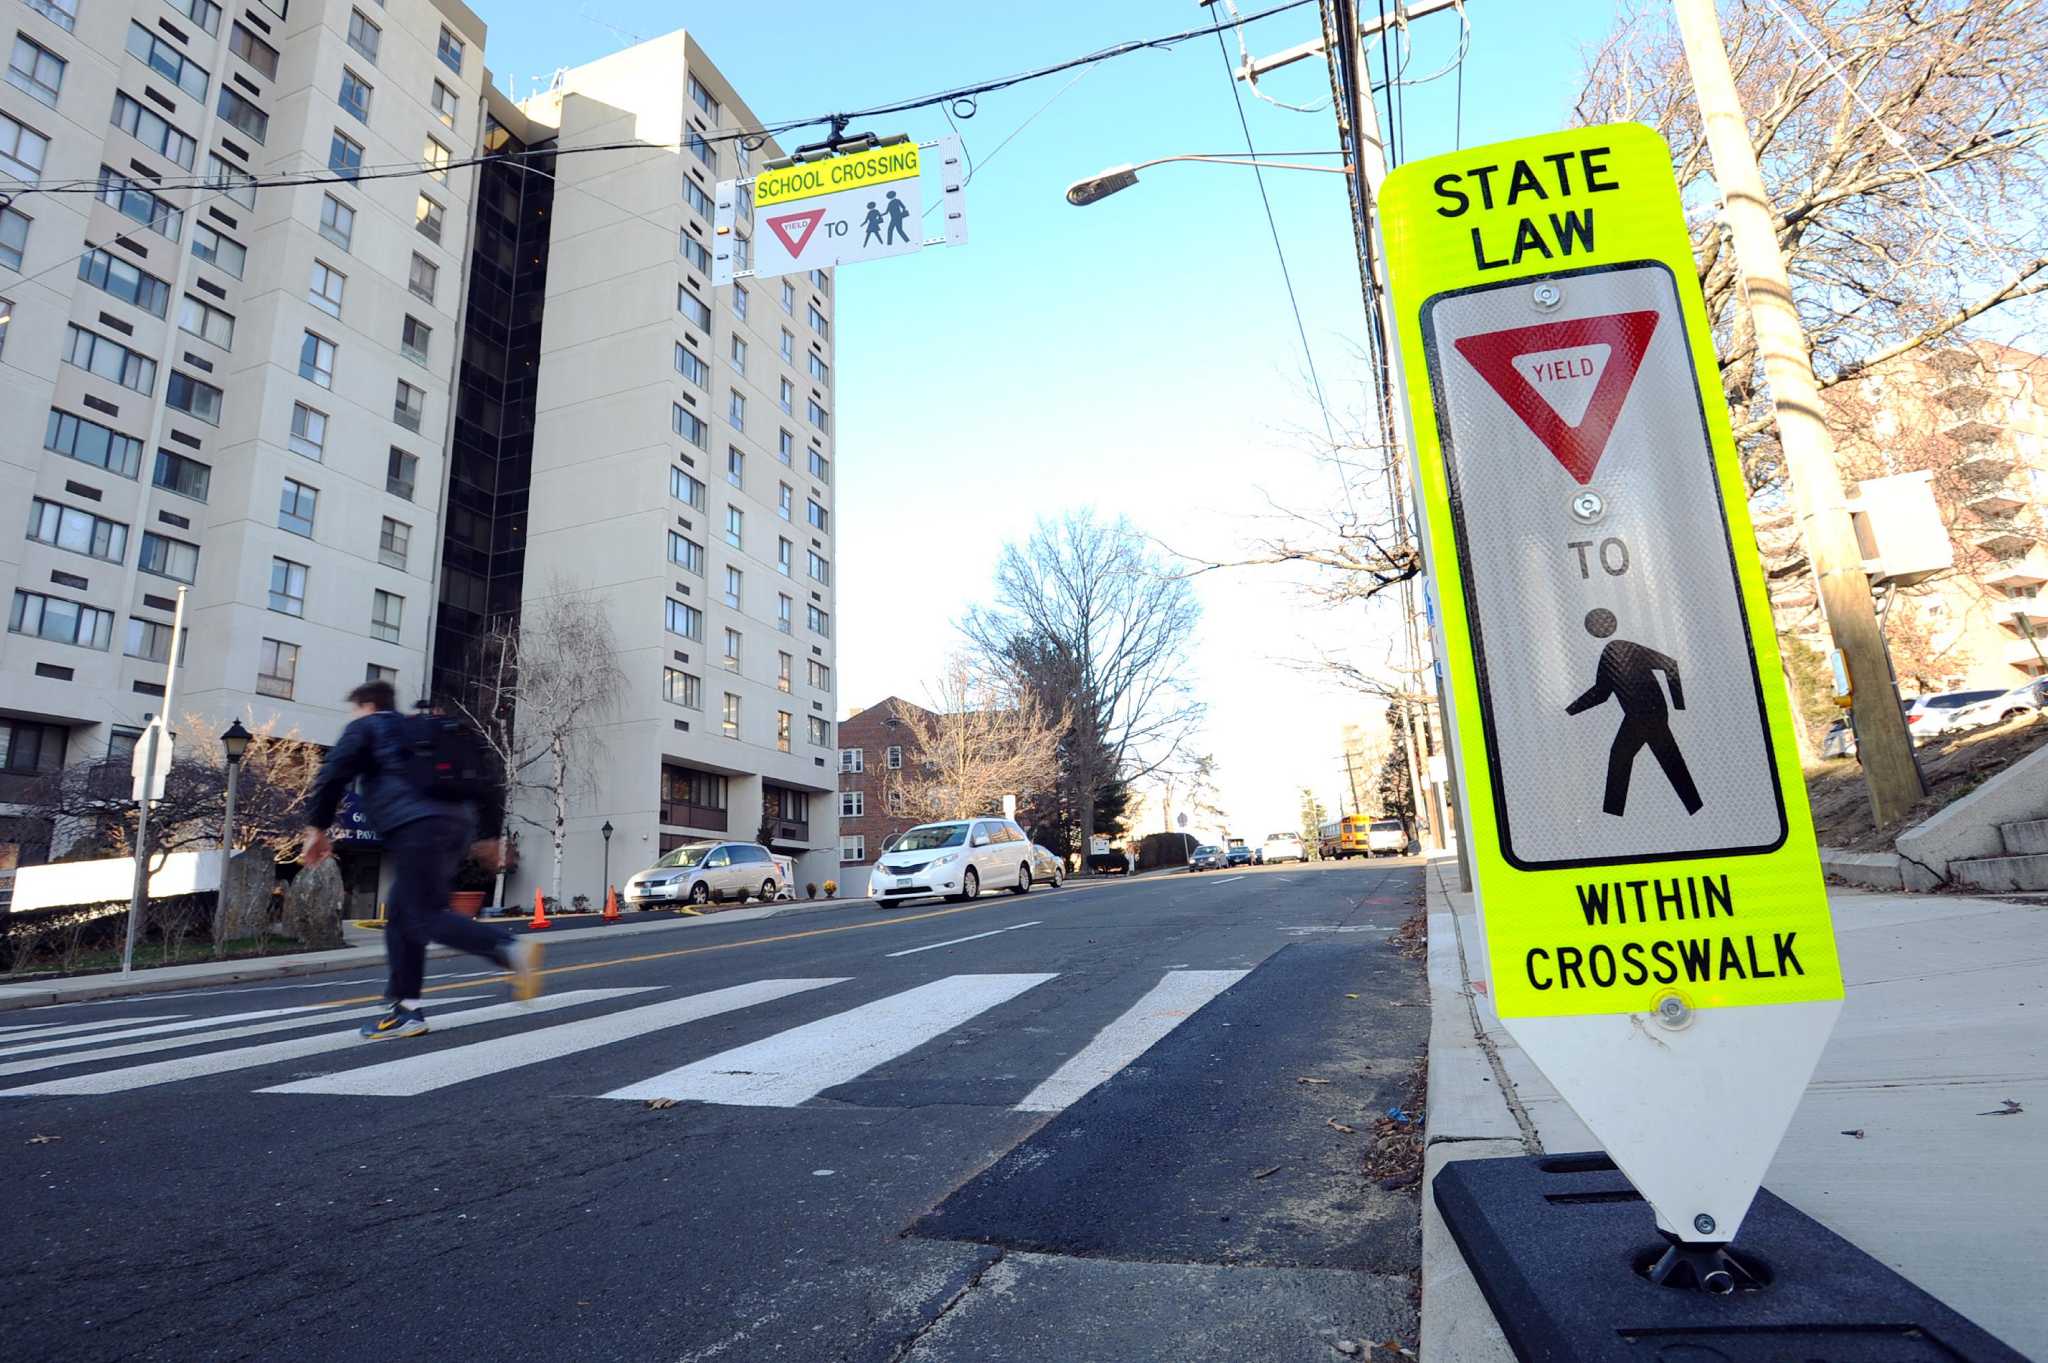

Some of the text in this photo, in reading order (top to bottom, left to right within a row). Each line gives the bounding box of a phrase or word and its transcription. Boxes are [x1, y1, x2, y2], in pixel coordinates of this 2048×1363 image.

[757, 151, 917, 199] SCHOOL CROSSING
[1434, 147, 1619, 217] STATE
[784, 220, 808, 231] YIELD
[824, 220, 848, 238] TO
[1471, 208, 1595, 271] LAW
[1532, 357, 1594, 383] YIELD
[1567, 537, 1630, 579] TO
[1576, 874, 1735, 926] WITHIN
[1526, 932, 1805, 991] CROSSWALK
